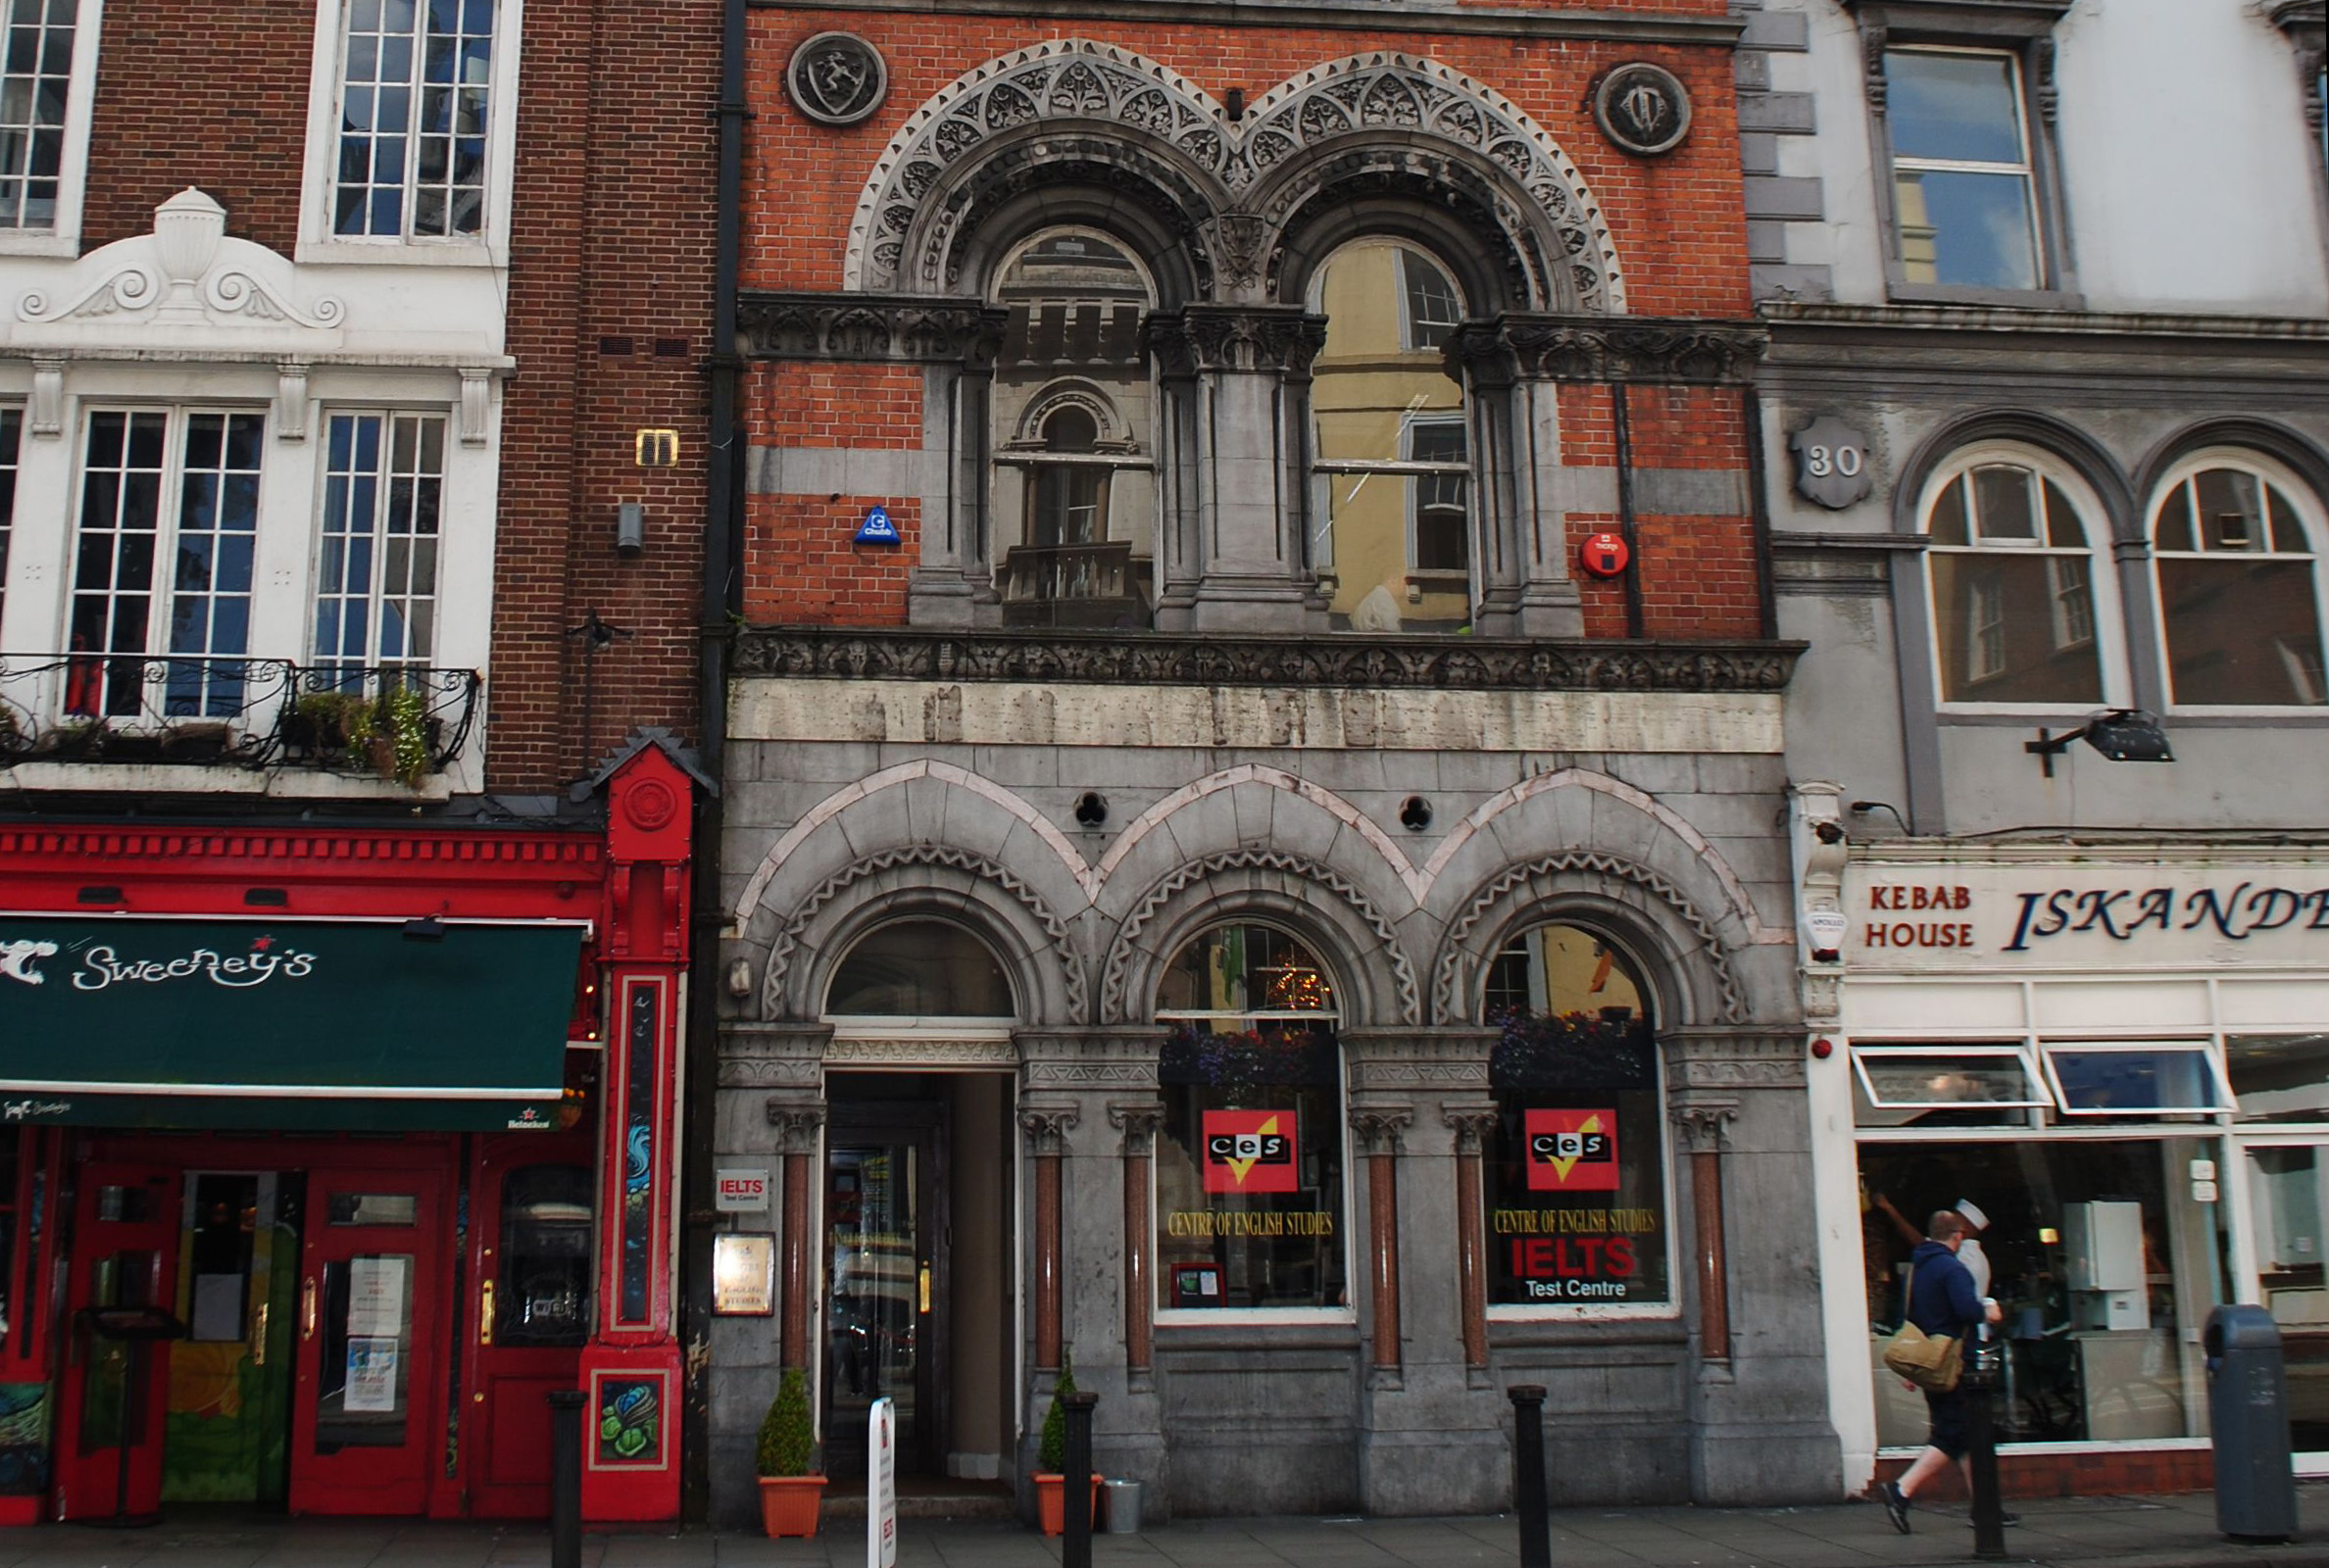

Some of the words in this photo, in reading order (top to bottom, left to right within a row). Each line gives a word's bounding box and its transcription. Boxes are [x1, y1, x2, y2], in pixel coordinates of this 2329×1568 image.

[1809, 445, 1861, 476] 30
[1869, 886, 1971, 910] KEBAB
[1865, 923, 1974, 948] HOUSE
[73, 946, 318, 990] Sweeney's
[1211, 1138, 1281, 1154] ces
[1533, 1136, 1603, 1152] ces
[720, 1179, 763, 1194] IELTS
[1168, 1211, 1214, 1236] CENTRE
[1216, 1211, 1233, 1236] OF
[1235, 1211, 1283, 1236] ENGLISH
[1286, 1211, 1333, 1236] STUDIES
[1495, 1209, 1539, 1233] CENTRE
[1541, 1209, 1557, 1232] OF
[1560, 1209, 1608, 1232] ENGLISH
[1610, 1208, 1656, 1232] STUDIES
[1511, 1237, 1636, 1278] IELTS
[1526, 1280, 1561, 1297] Test
[1566, 1279, 1626, 1297] Centre
